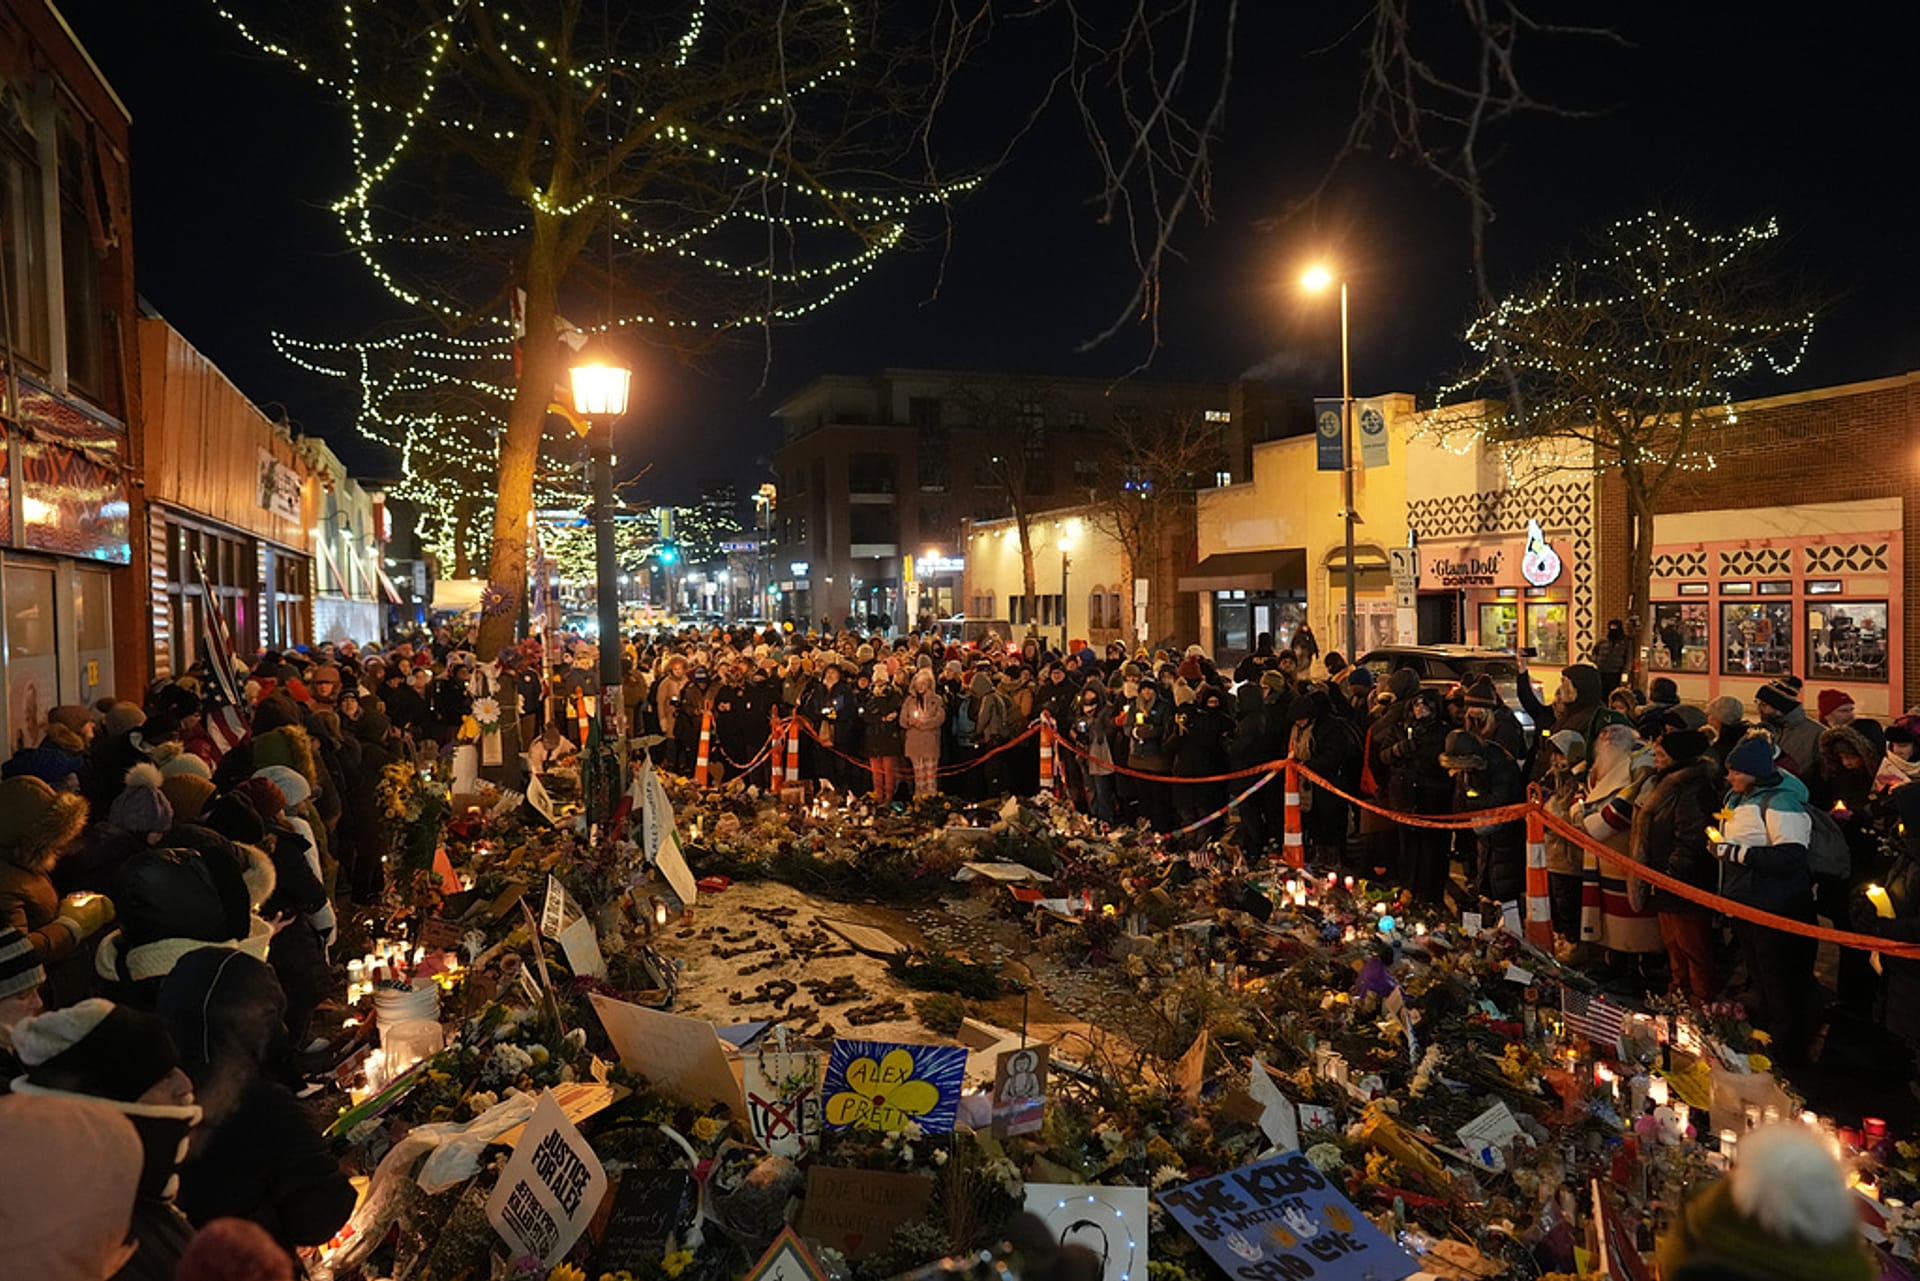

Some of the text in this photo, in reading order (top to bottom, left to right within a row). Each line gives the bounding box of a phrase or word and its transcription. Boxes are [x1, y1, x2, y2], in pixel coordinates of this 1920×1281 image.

[1435, 557, 1499, 577] Glam Doll
[1442, 576, 1494, 586] DONUTS
[852, 1064, 909, 1085] ALEX
[531, 1143, 592, 1222] FOR ALEX
[543, 1128, 592, 1197] JUSTICE
[1163, 1155, 1327, 1219] THE KIDS
[506, 1191, 536, 1232] KILLED
[1193, 1213, 1225, 1241] OF
[1236, 1229, 1369, 1281] SEND LOVE
